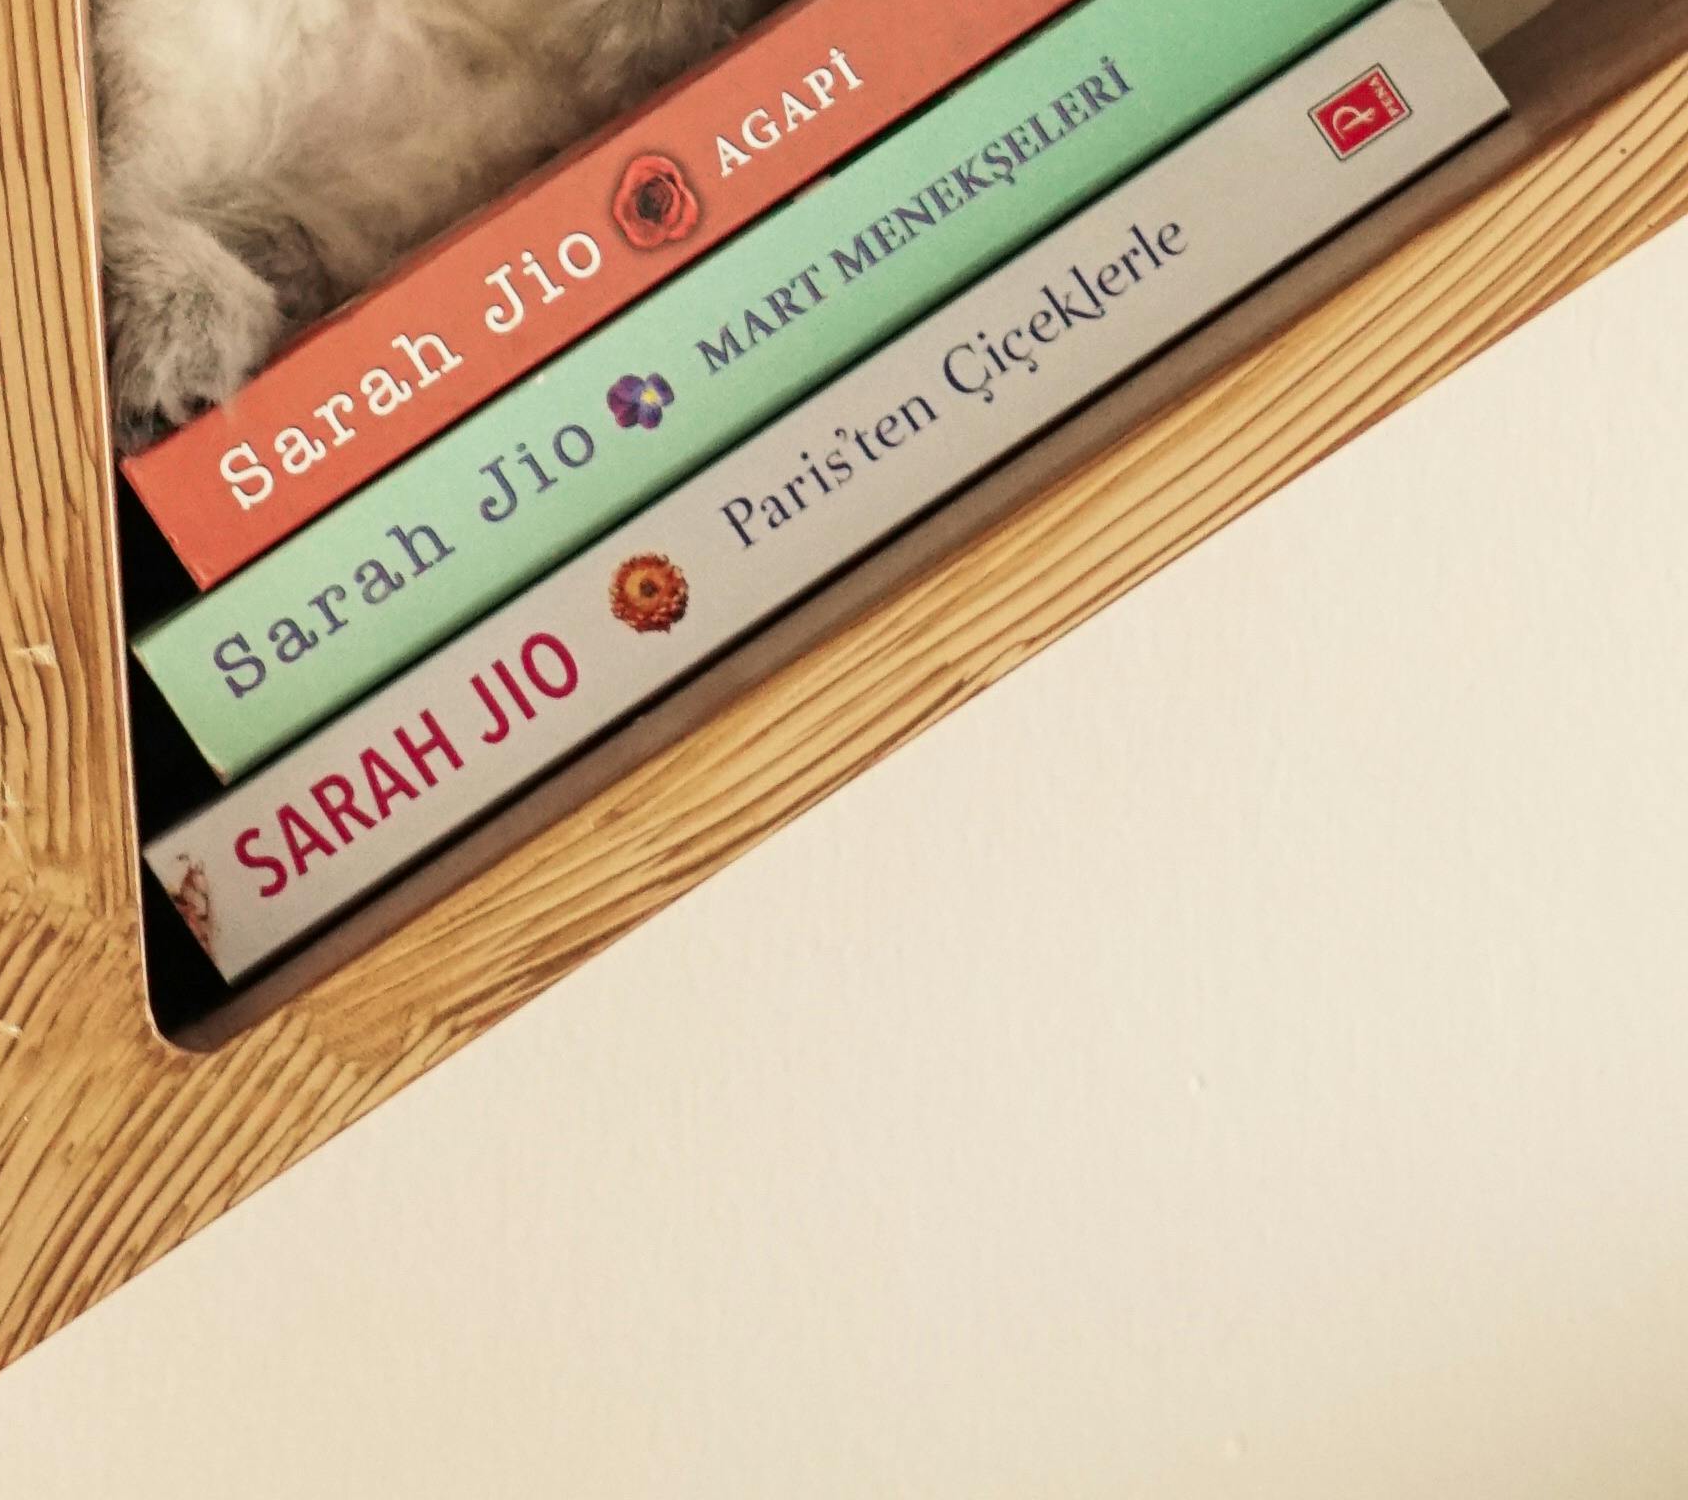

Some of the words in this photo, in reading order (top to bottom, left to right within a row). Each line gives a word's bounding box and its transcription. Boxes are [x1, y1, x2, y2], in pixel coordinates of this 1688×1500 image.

[211, 516, 457, 701] Sarah
[476, 420, 598, 525] Jio
[693, 263, 831, 378] MART
[834, 54, 1137, 284] MENEKŞELERİ
[218, 326, 463, 510] Sarah
[483, 230, 602, 335] Jio
[717, 46, 865, 179] AGAPİ
[234, 707, 466, 899] SARAH
[475, 630, 580, 747] JIO
[720, 394, 941, 552] Paris'ten
[941, 211, 1190, 404] Çiçeklerle
